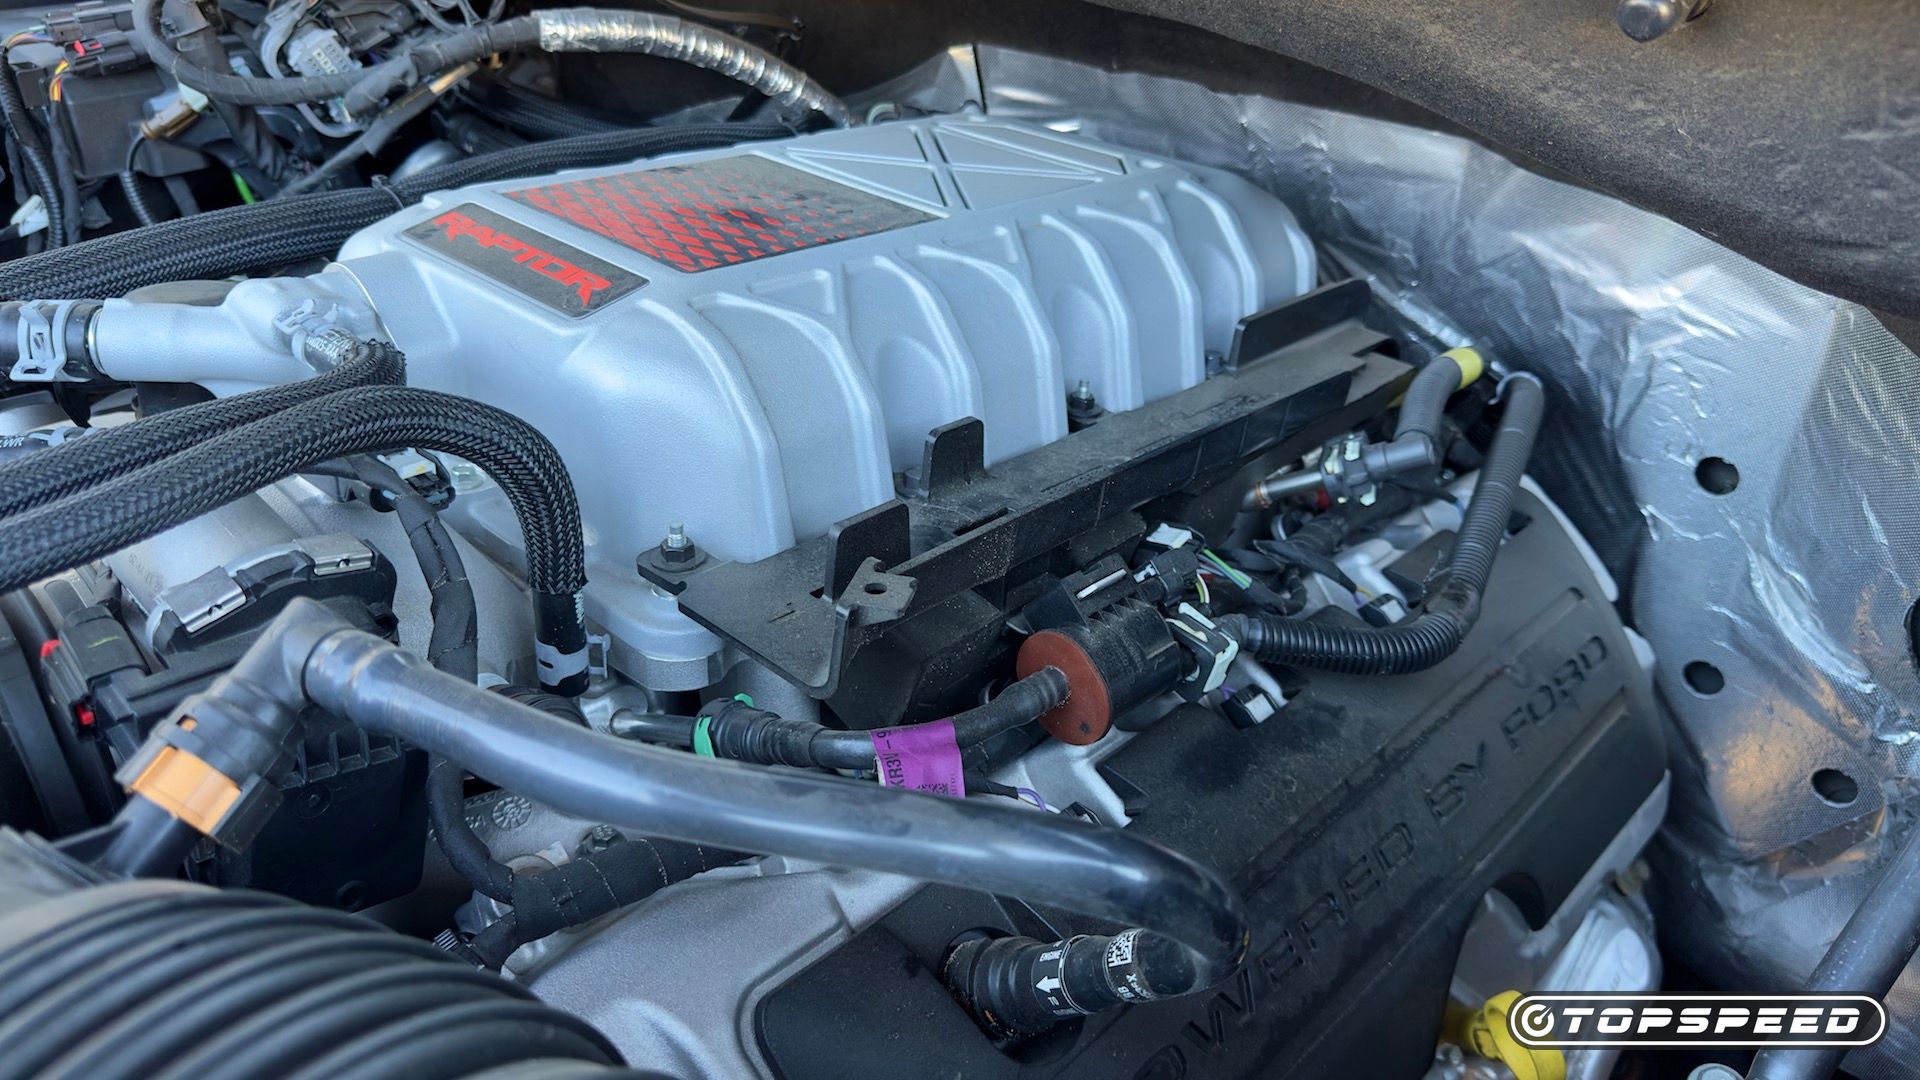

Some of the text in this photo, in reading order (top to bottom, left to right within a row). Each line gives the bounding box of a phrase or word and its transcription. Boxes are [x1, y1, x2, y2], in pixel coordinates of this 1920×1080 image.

[432, 211, 613, 307] RAPTOR
[1130, 635, 1608, 1080] OWERED BY FORD
